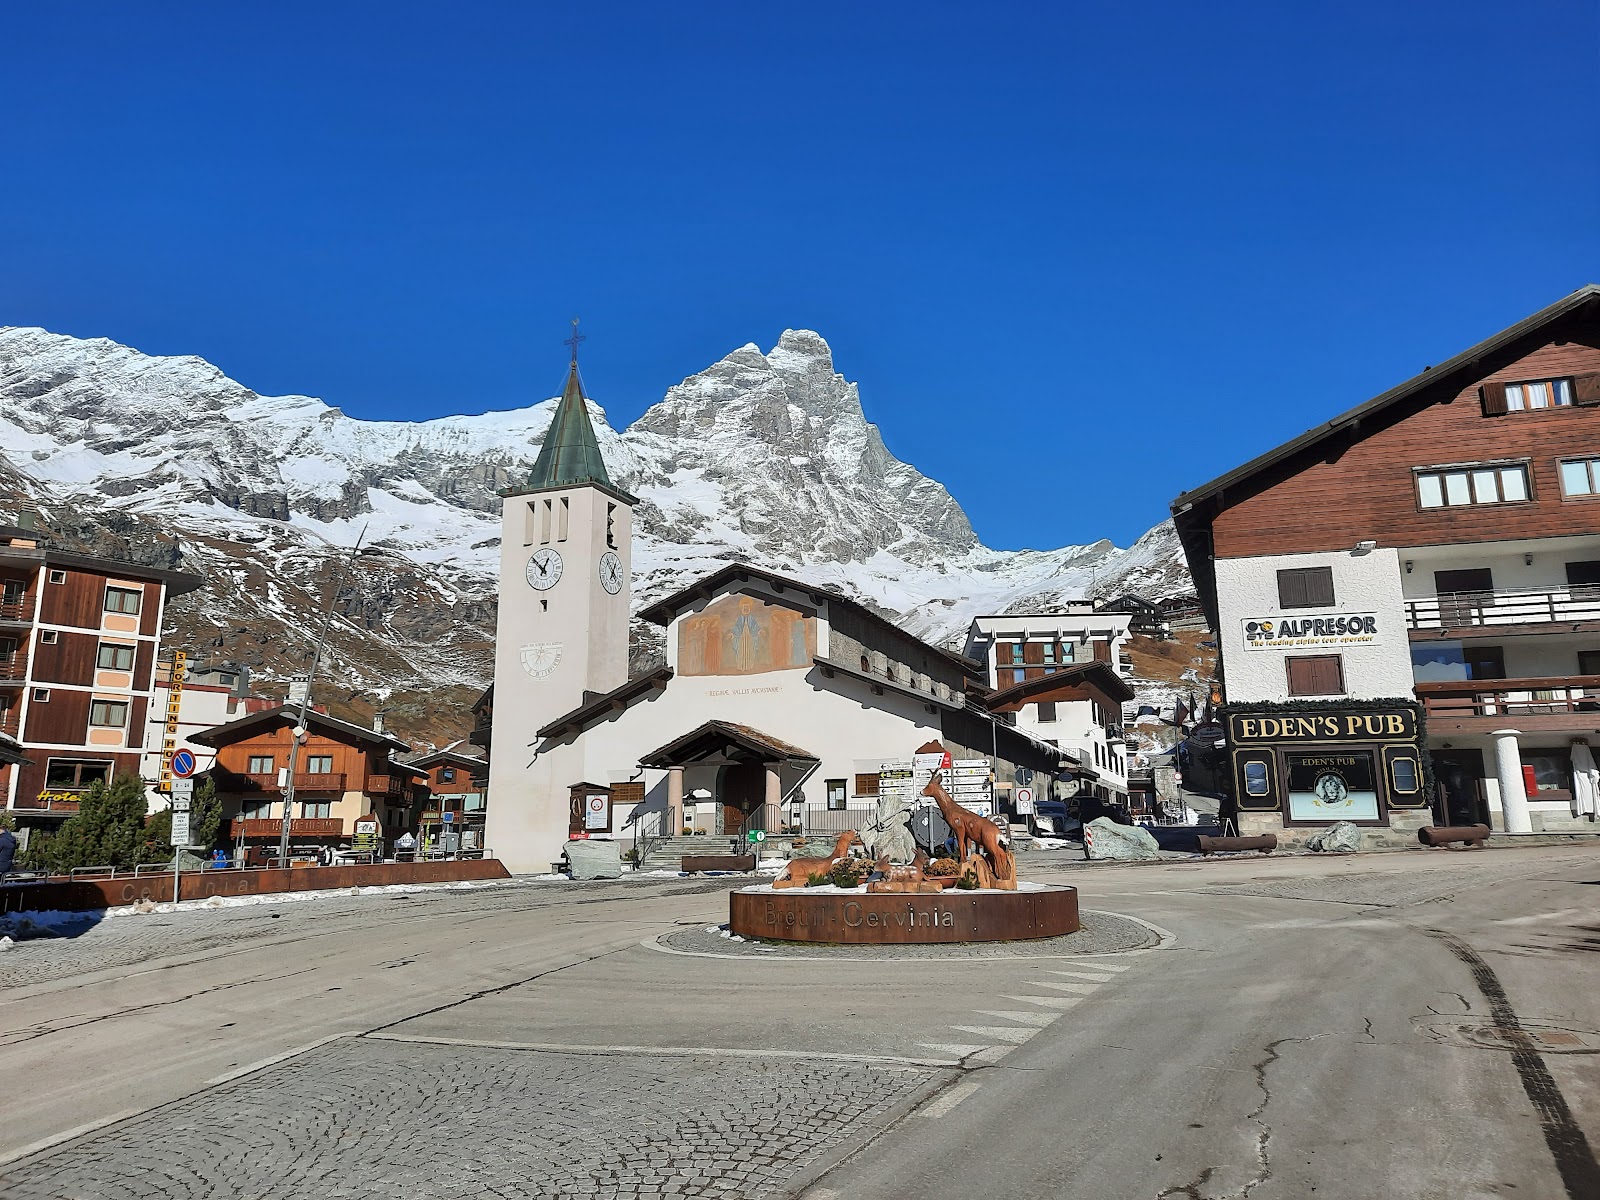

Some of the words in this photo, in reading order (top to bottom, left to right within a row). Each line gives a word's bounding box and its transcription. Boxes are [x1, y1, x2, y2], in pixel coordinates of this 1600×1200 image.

[1277, 616, 1378, 638] ALPRESOR
[1266, 639, 1294, 647] leading
[1295, 638, 1320, 646] alpine
[1340, 635, 1374, 644] operator
[167, 653, 185, 733] SPORTING
[1240, 716, 1339, 738] EDEN'S
[1345, 714, 1405, 735] PUB
[161, 740, 175, 791] HOTEL
[1302, 758, 1335, 766] EDEN'S
[1337, 757, 1356, 766] PUB
